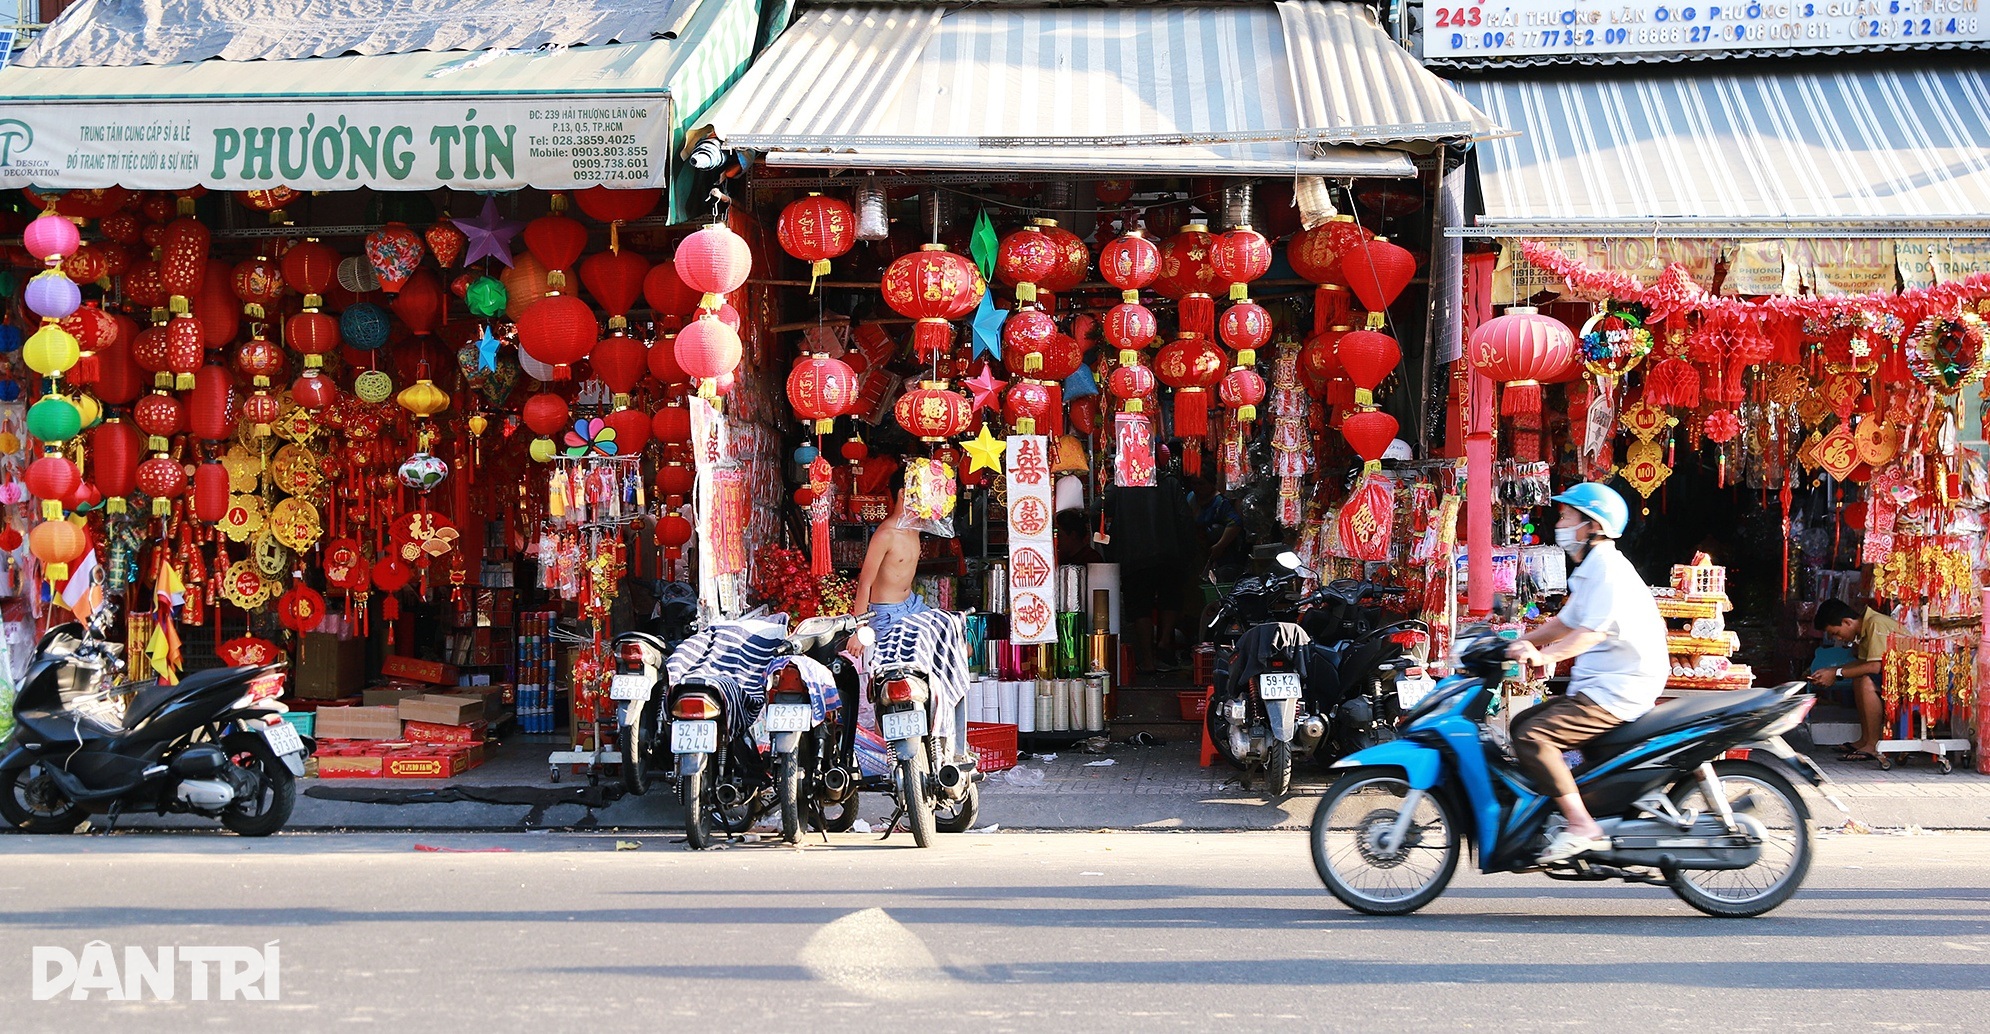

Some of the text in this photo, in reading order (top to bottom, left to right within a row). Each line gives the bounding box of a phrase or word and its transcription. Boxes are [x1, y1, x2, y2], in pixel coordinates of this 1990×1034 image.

[1436, 7, 1482, 28] 243
[1487, 7, 1518, 27] HẢI
[1526, 8, 1602, 28] THƯỢNG
[1796, 3, 1814, 18] 13
[1890, 1, 1899, 14] 5
[529, 109, 543, 120] ĐC:
[544, 109, 560, 120] 239
[562, 106, 576, 120] HẢI
[577, 107, 610, 121] THƯỢNG
[629, 106, 647, 119] ÔNG
[80, 119, 191, 142] TRUNG TÂM CUNG CẤP SỈ & LẺ
[552, 121, 623, 133] P.13, Q.5, TP.HCM
[210, 107, 517, 180] PHƯƠNG TÍN
[529, 134, 636, 146] Tel: 028.3859.4025
[529, 146, 648, 158] Mobile: 0903.803.855
[80, 153, 105, 170] TRANG
[106, 150, 120, 170] TRÍ
[121, 149, 139, 173] TIỆC
[140, 149, 159, 170] CƯỚI
[160, 154, 166, 170] &
[180, 149, 199, 173] KIỆN
[572, 158, 649, 169] 0909.738.601
[4, 168, 60, 177] DECORATION
[573, 169, 650, 180] 0932.774.004
[1007, 439, 1047, 485] 囍
[1637, 465, 1654, 478] MỚI
[1265, 675, 1294, 686] 59-K2
[1264, 686, 1299, 698] 407.59
[774, 706, 805, 717] 62-S1
[772, 718, 804, 729] 6763
[889, 711, 920, 727] 51-K3
[678, 723, 709, 737] 52-M9
[677, 737, 709, 751] 4244
